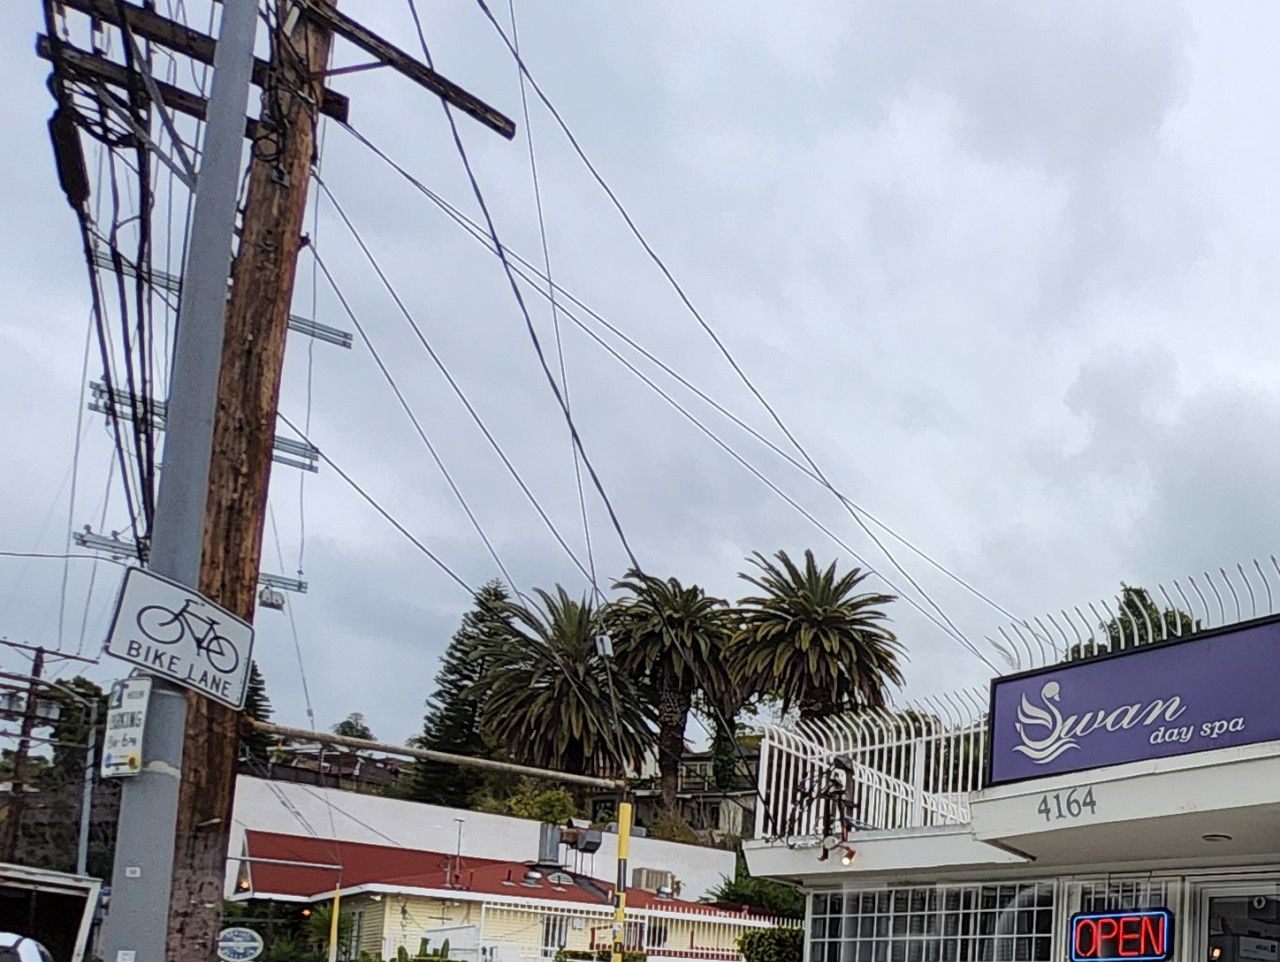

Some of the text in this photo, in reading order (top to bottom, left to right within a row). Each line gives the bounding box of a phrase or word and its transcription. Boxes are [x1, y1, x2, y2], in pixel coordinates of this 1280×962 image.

[127, 640, 232, 698] BIKE LANE
[1013, 682, 1187, 760] Swan
[1150, 717, 1245, 745] day spa
[1037, 785, 1097, 822] 4164
[1075, 916, 1164, 957] OPEN
